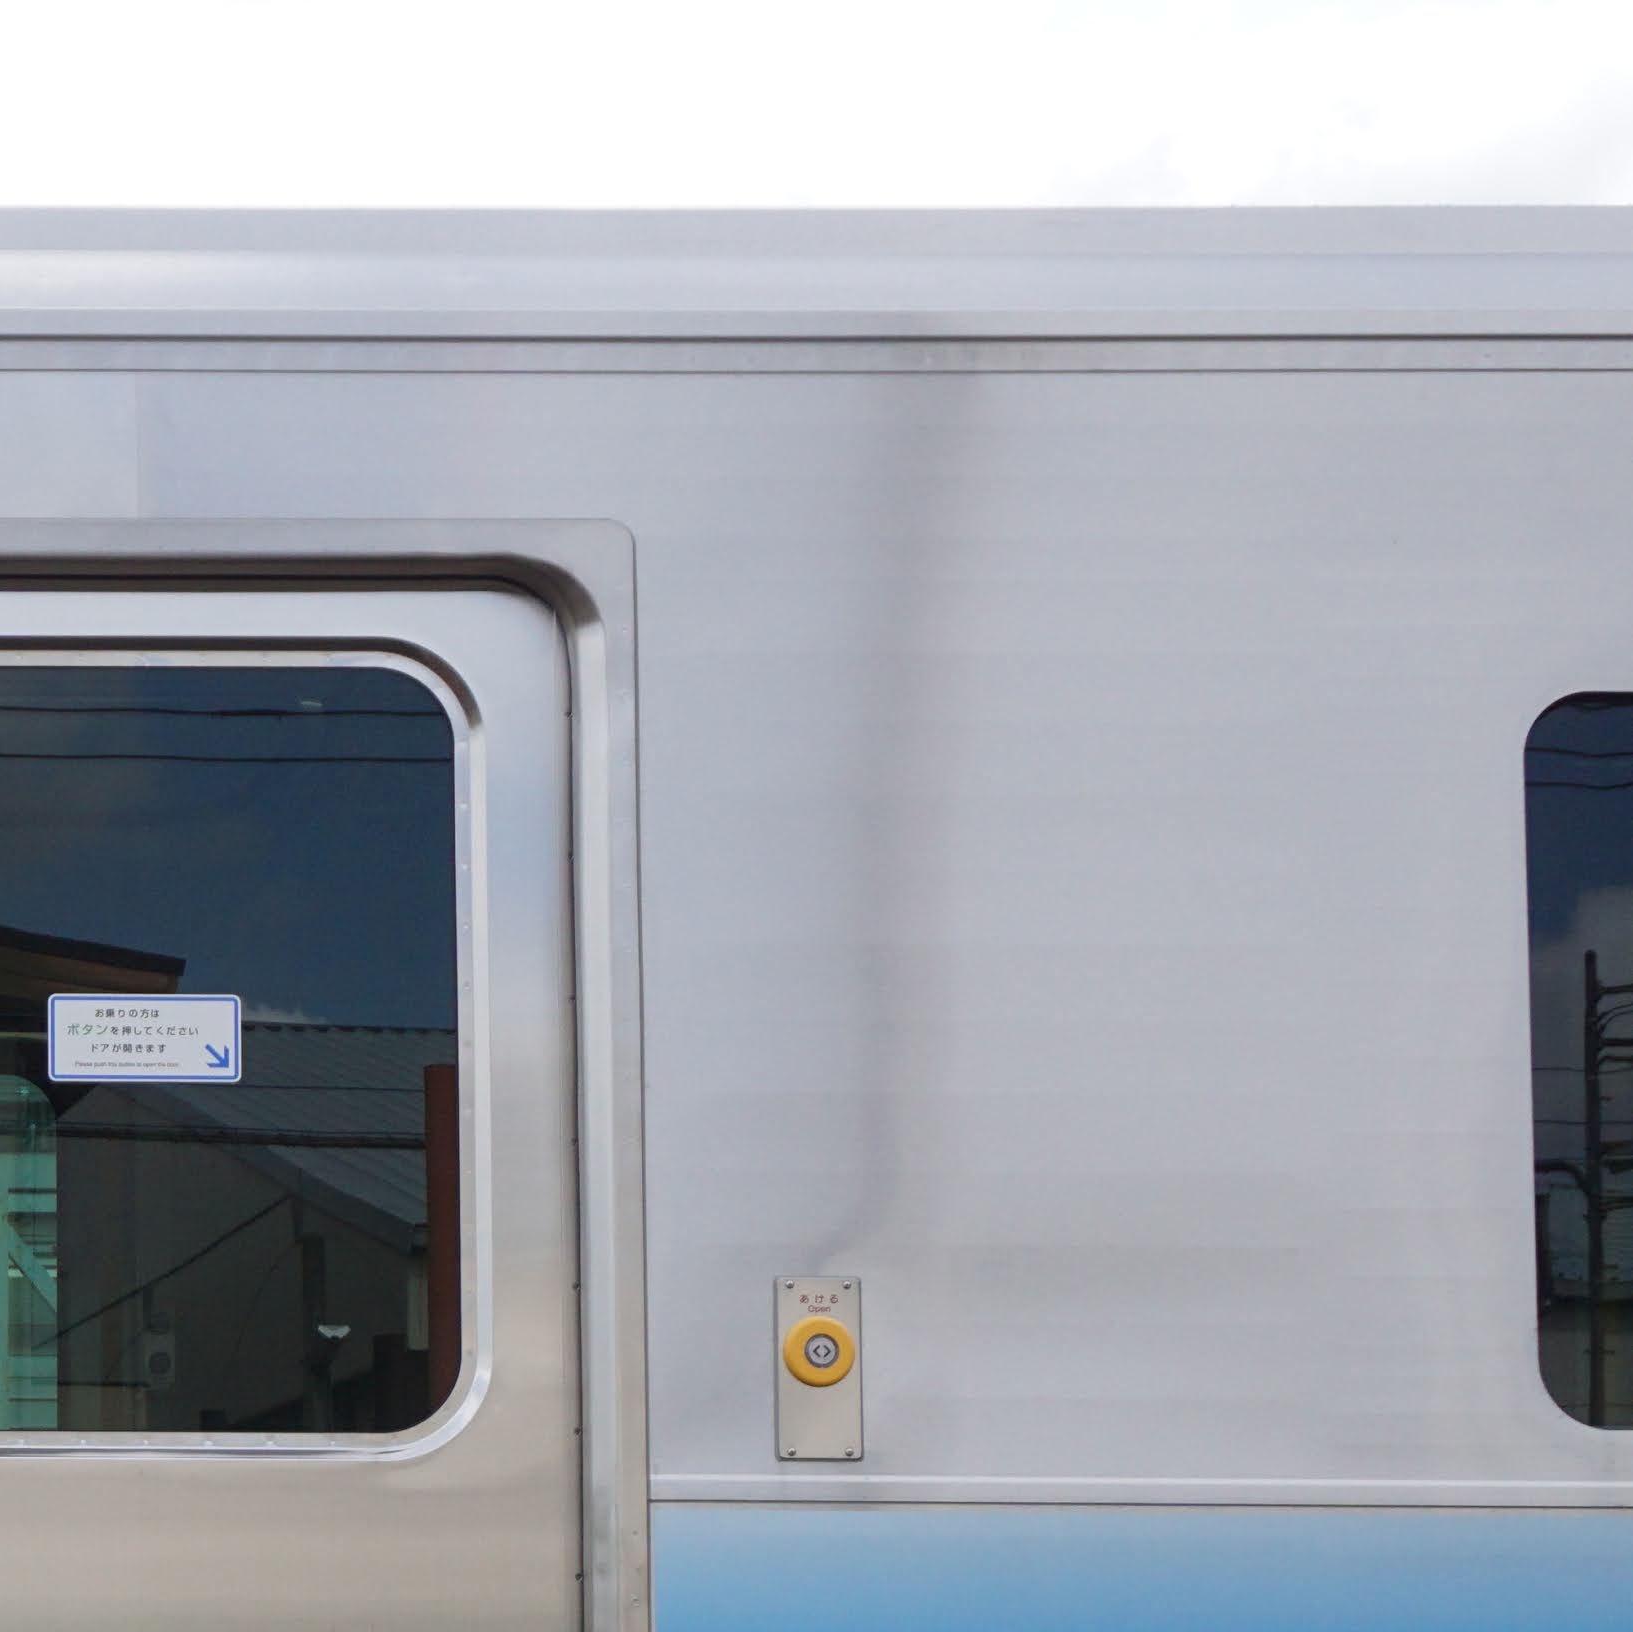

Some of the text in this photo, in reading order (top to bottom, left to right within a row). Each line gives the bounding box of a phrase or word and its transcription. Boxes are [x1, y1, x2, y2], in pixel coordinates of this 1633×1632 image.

[94, 1008, 160, 1019] お乗りの方は
[66, 1023, 199, 1036] ボタンを押してください
[91, 1043, 167, 1053] ドアが開きます
[799, 1294, 839, 1304] あける
[807, 1304, 832, 1313] Open
